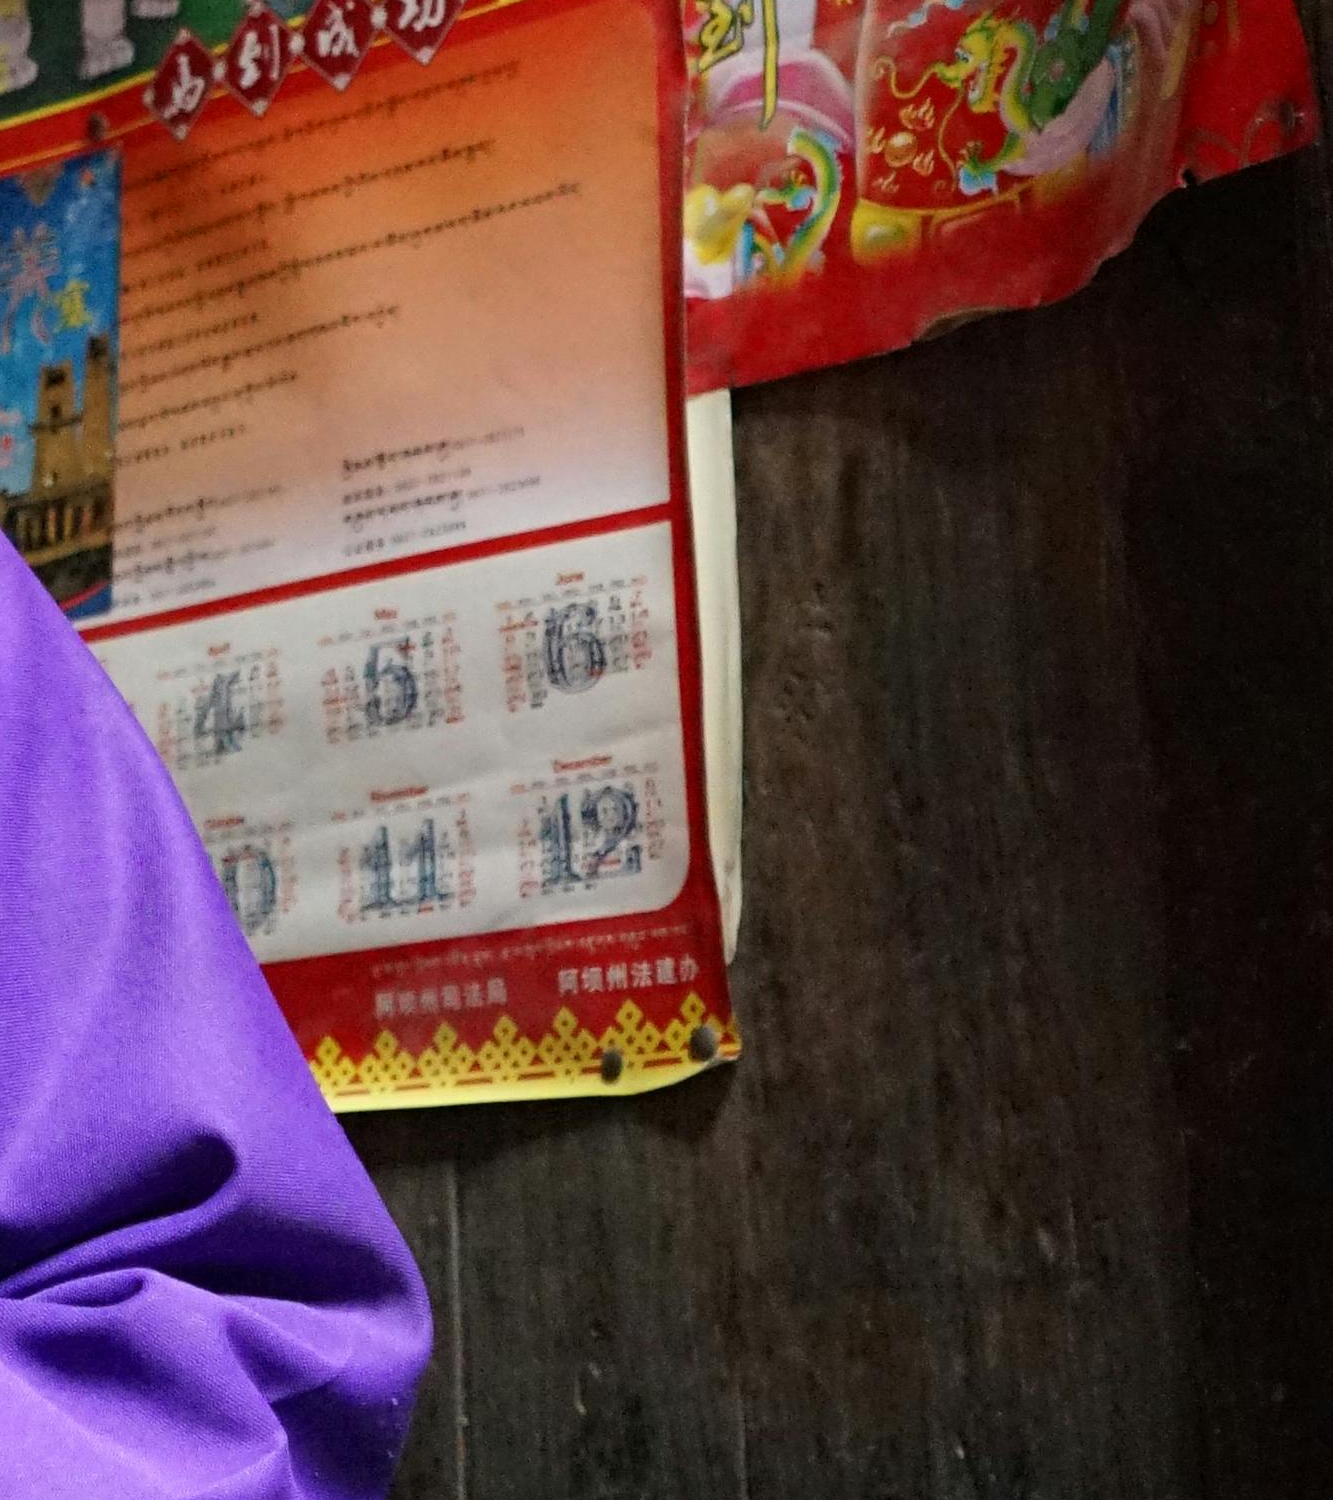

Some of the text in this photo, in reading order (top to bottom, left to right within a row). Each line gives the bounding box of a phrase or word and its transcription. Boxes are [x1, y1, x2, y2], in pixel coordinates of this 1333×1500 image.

[363, 637, 420, 728] 5
[542, 602, 608, 695] 6
[359, 817, 454, 914] 11
[536, 784, 645, 886] 12
